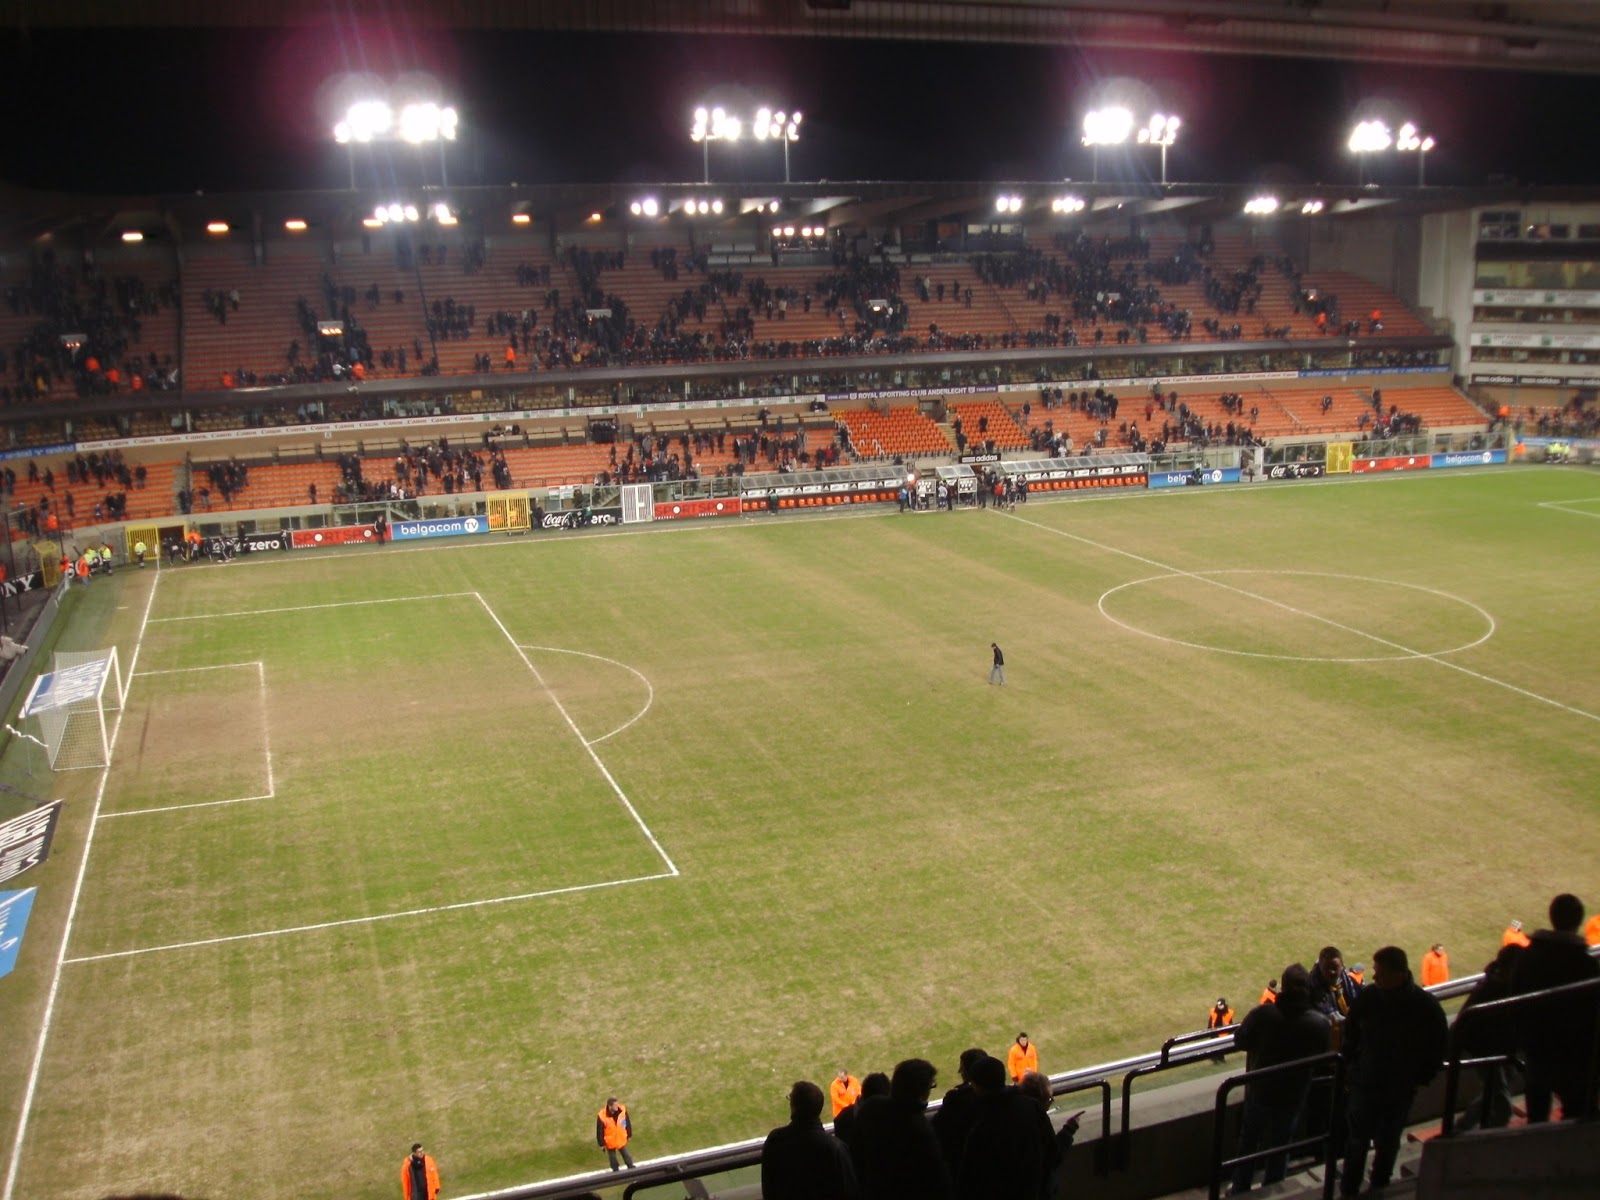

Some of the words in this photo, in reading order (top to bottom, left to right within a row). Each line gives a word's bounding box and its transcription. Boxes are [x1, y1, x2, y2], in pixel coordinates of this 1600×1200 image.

[879, 390, 910, 398] SPORTING
[928, 387, 967, 396] ANDERLECHT
[975, 454, 998, 462] adidas
[1445, 455, 1483, 464] belgacom
[401, 522, 462, 536] belgacom
[249, 539, 280, 551] zero
